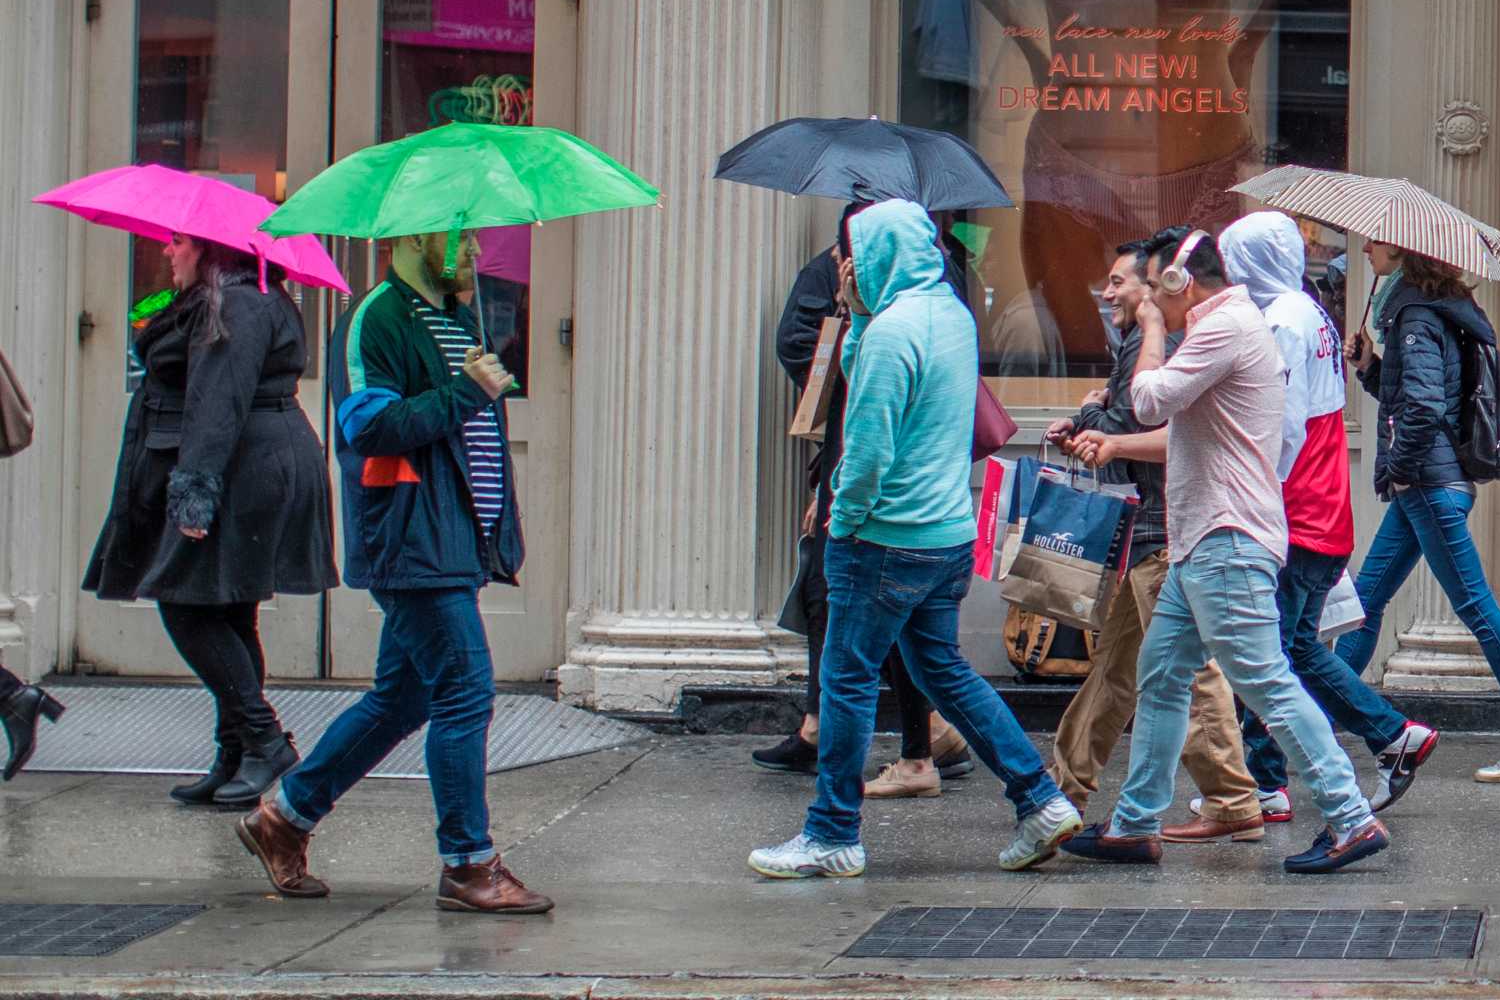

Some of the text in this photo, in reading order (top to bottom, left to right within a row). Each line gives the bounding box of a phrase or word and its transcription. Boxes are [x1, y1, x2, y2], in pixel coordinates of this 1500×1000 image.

[1047, 52, 1199, 80] ALL NEW!
[998, 86, 1249, 114] DREAM ANGELS
[1032, 533, 1085, 559] HOLLISTER
